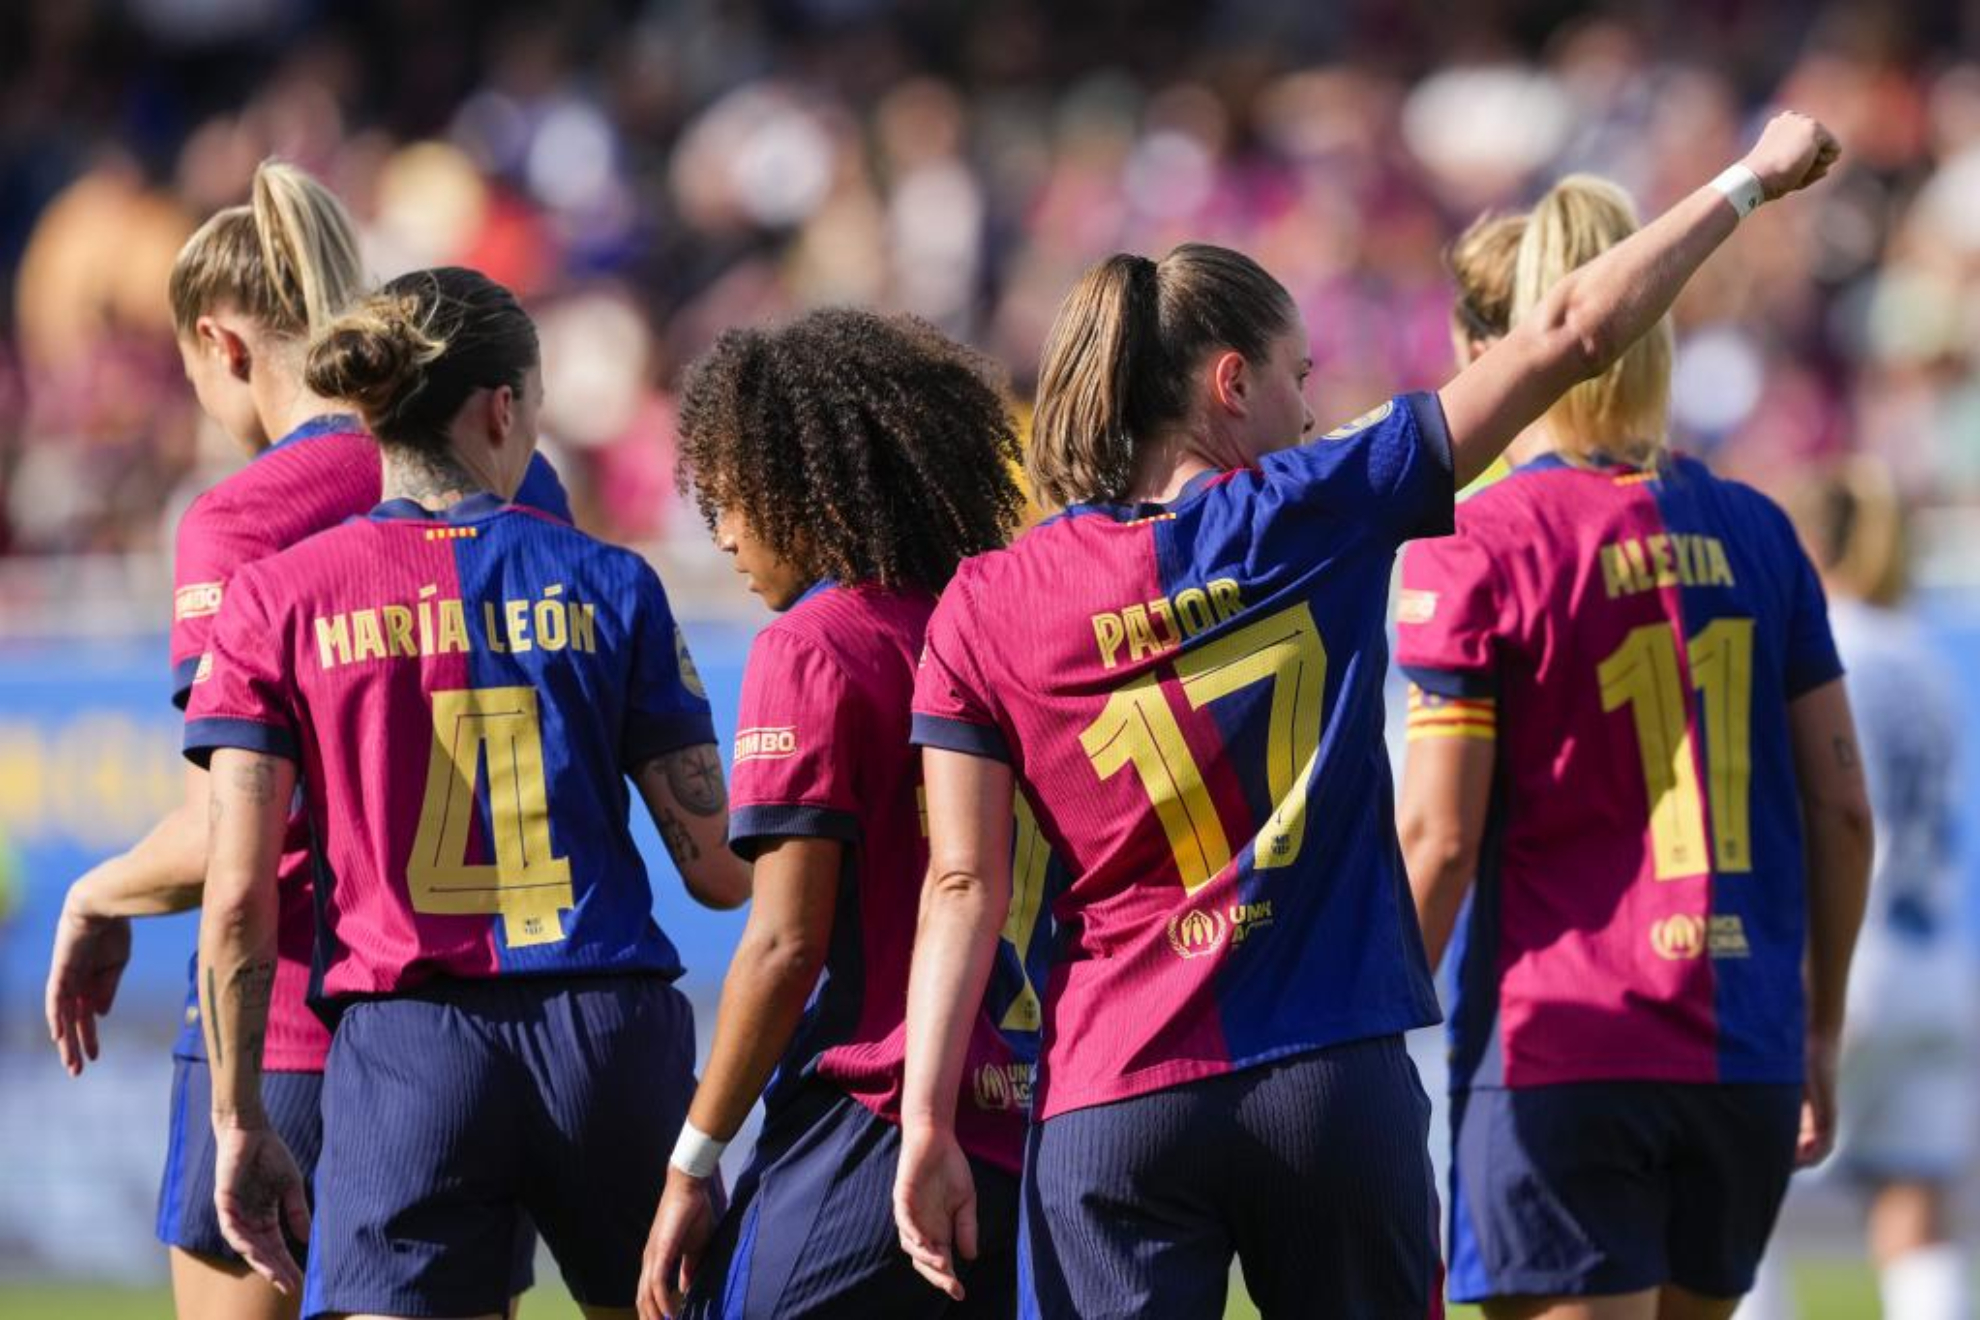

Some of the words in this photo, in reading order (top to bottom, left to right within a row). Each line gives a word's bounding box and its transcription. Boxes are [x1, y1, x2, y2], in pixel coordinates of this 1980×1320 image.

[314, 584, 470, 669] MARÍA
[484, 584, 596, 653] LEÓN
[1091, 578, 1244, 668] PAJOR
[1600, 532, 1735, 599] ALEXIA
[407, 686, 574, 948] 4
[1078, 601, 1328, 898] 17
[1596, 618, 1755, 882] 11
